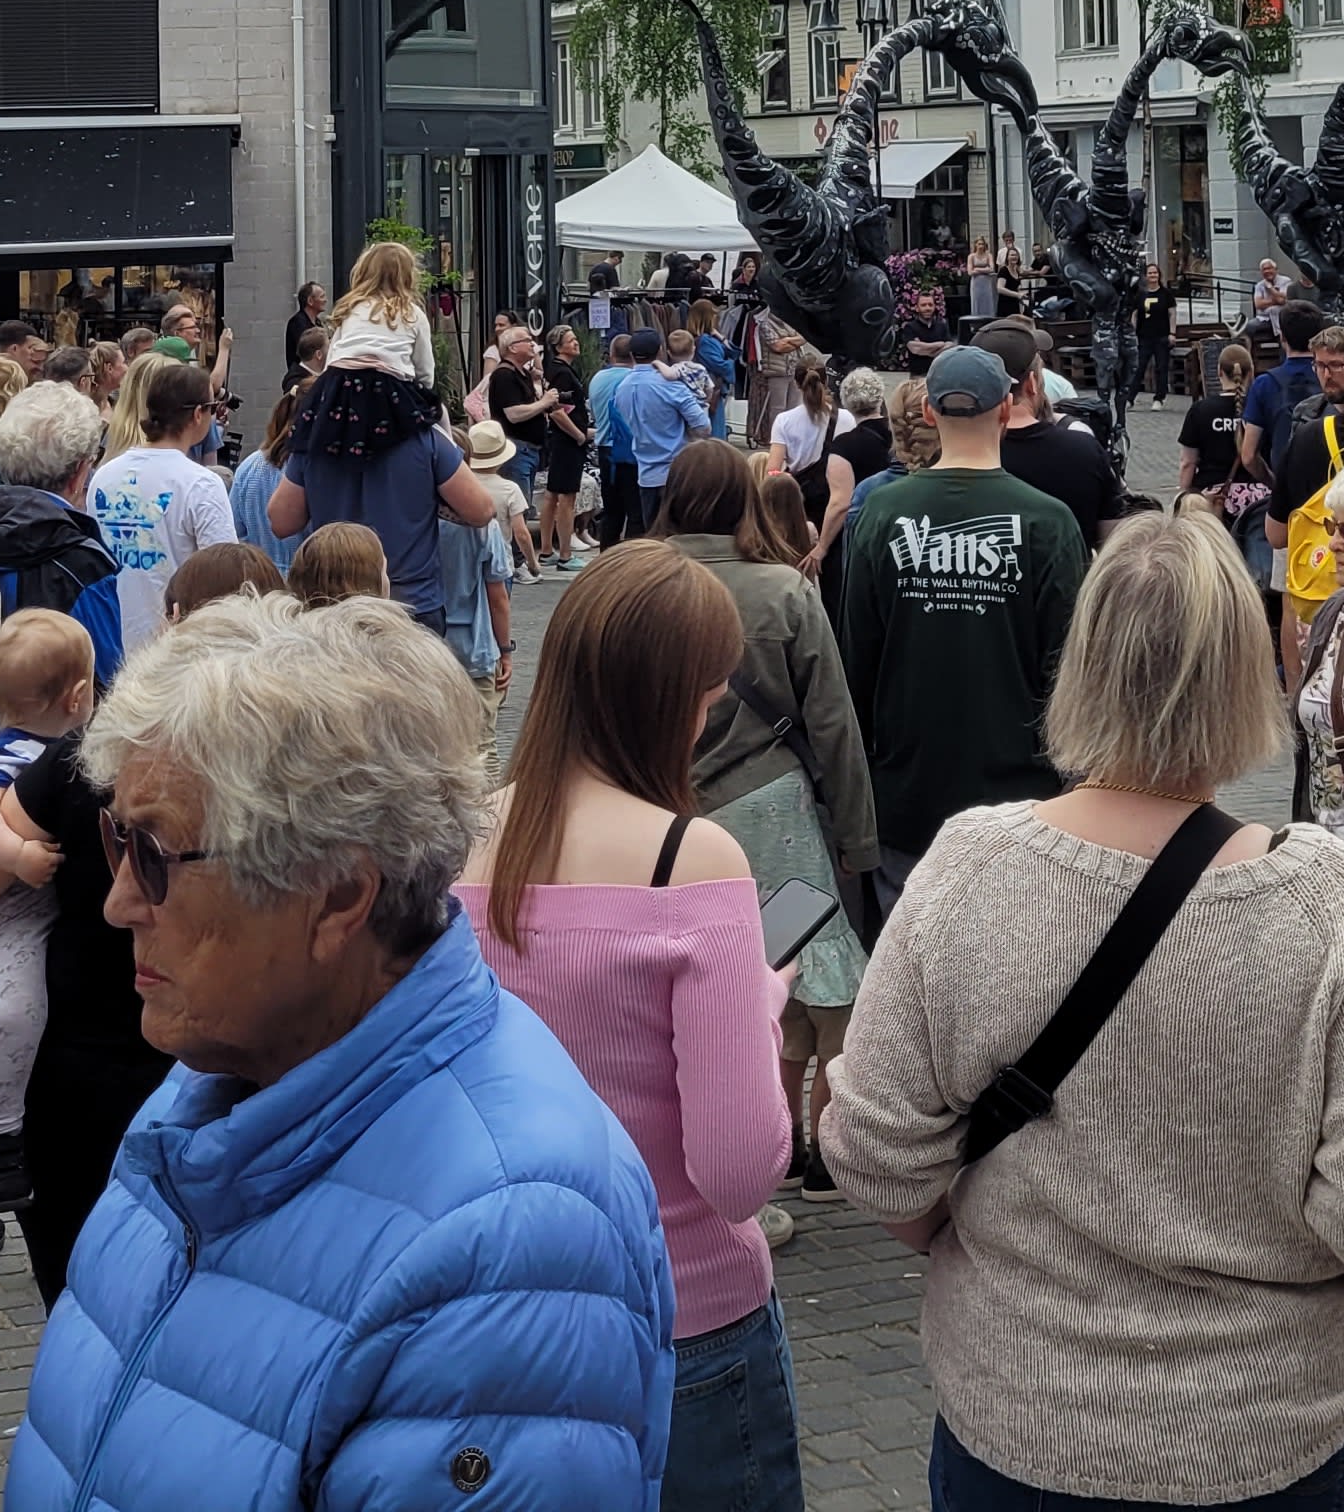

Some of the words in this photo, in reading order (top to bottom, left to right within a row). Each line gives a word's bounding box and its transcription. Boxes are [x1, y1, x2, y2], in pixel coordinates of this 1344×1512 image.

[894, 514, 1001, 577] Vans
[911, 577, 929, 589] THE
[931, 578, 960, 589] WALL
[962, 579, 1000, 592] RHYTHM
[1001, 582, 1020, 595] CO.
